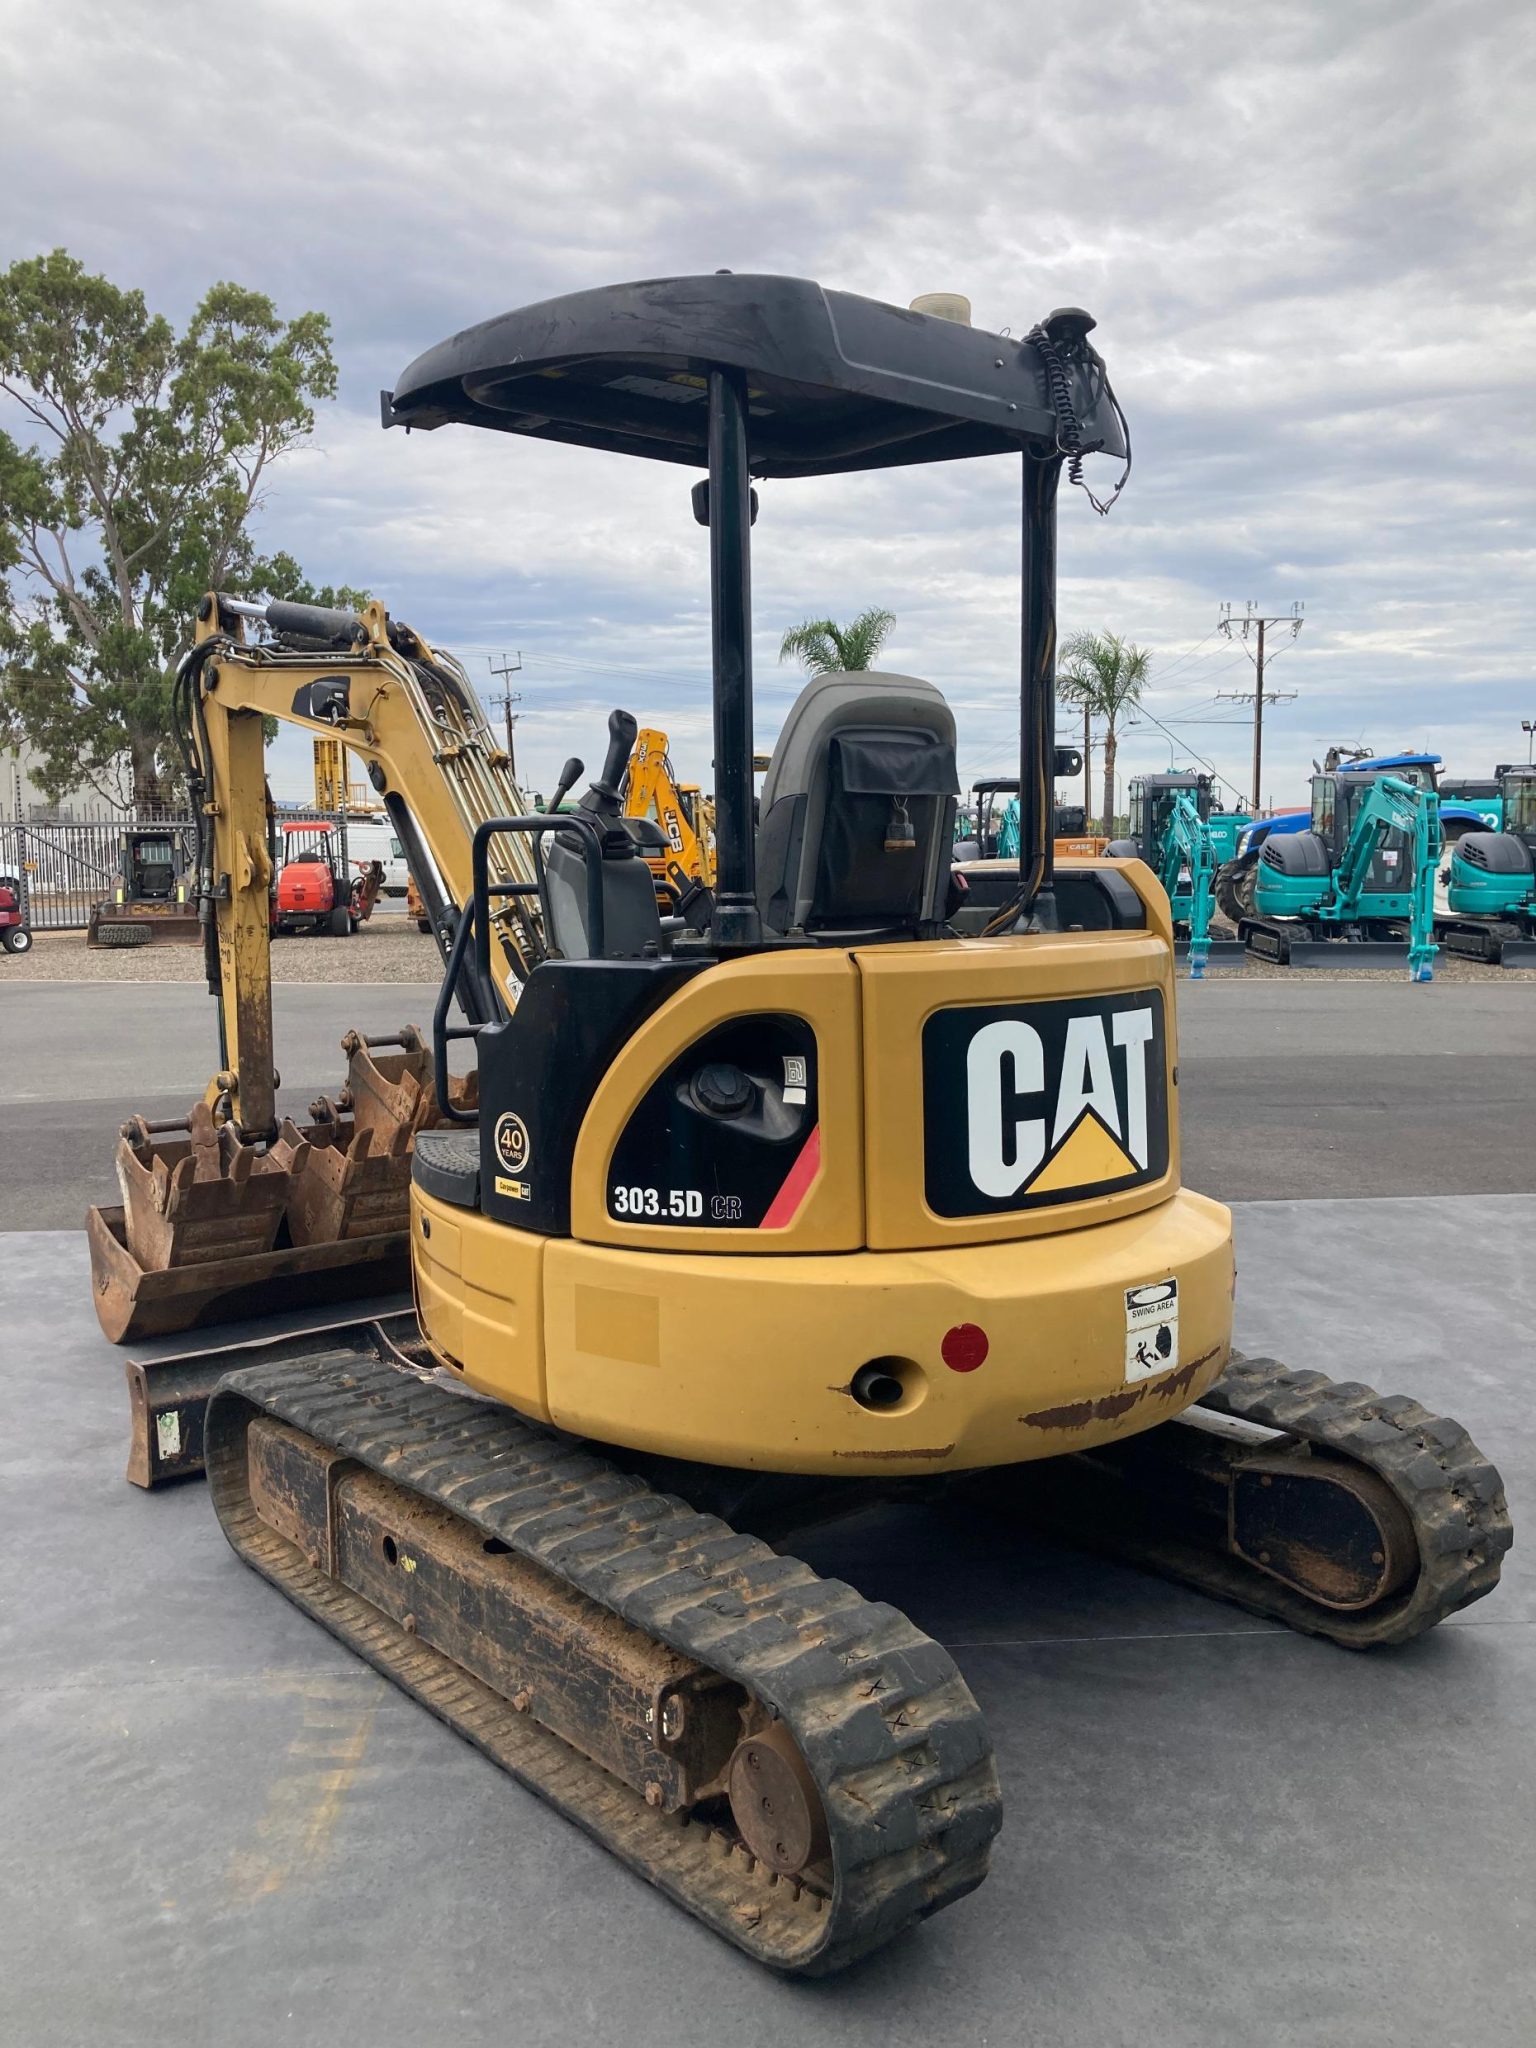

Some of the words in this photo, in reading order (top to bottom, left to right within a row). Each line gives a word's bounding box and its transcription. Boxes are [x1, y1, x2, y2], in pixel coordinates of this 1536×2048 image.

[664, 810, 683, 853] JCB
[966, 1007, 1154, 1198] CAT
[500, 1128, 523, 1150] 40
[501, 1148, 523, 1160] YEARS
[614, 1186, 703, 1218] 303.5D
[710, 1195, 742, 1220] CR
[1131, 1304, 1155, 1318] SWING
[1156, 1299, 1175, 1313] AREA
